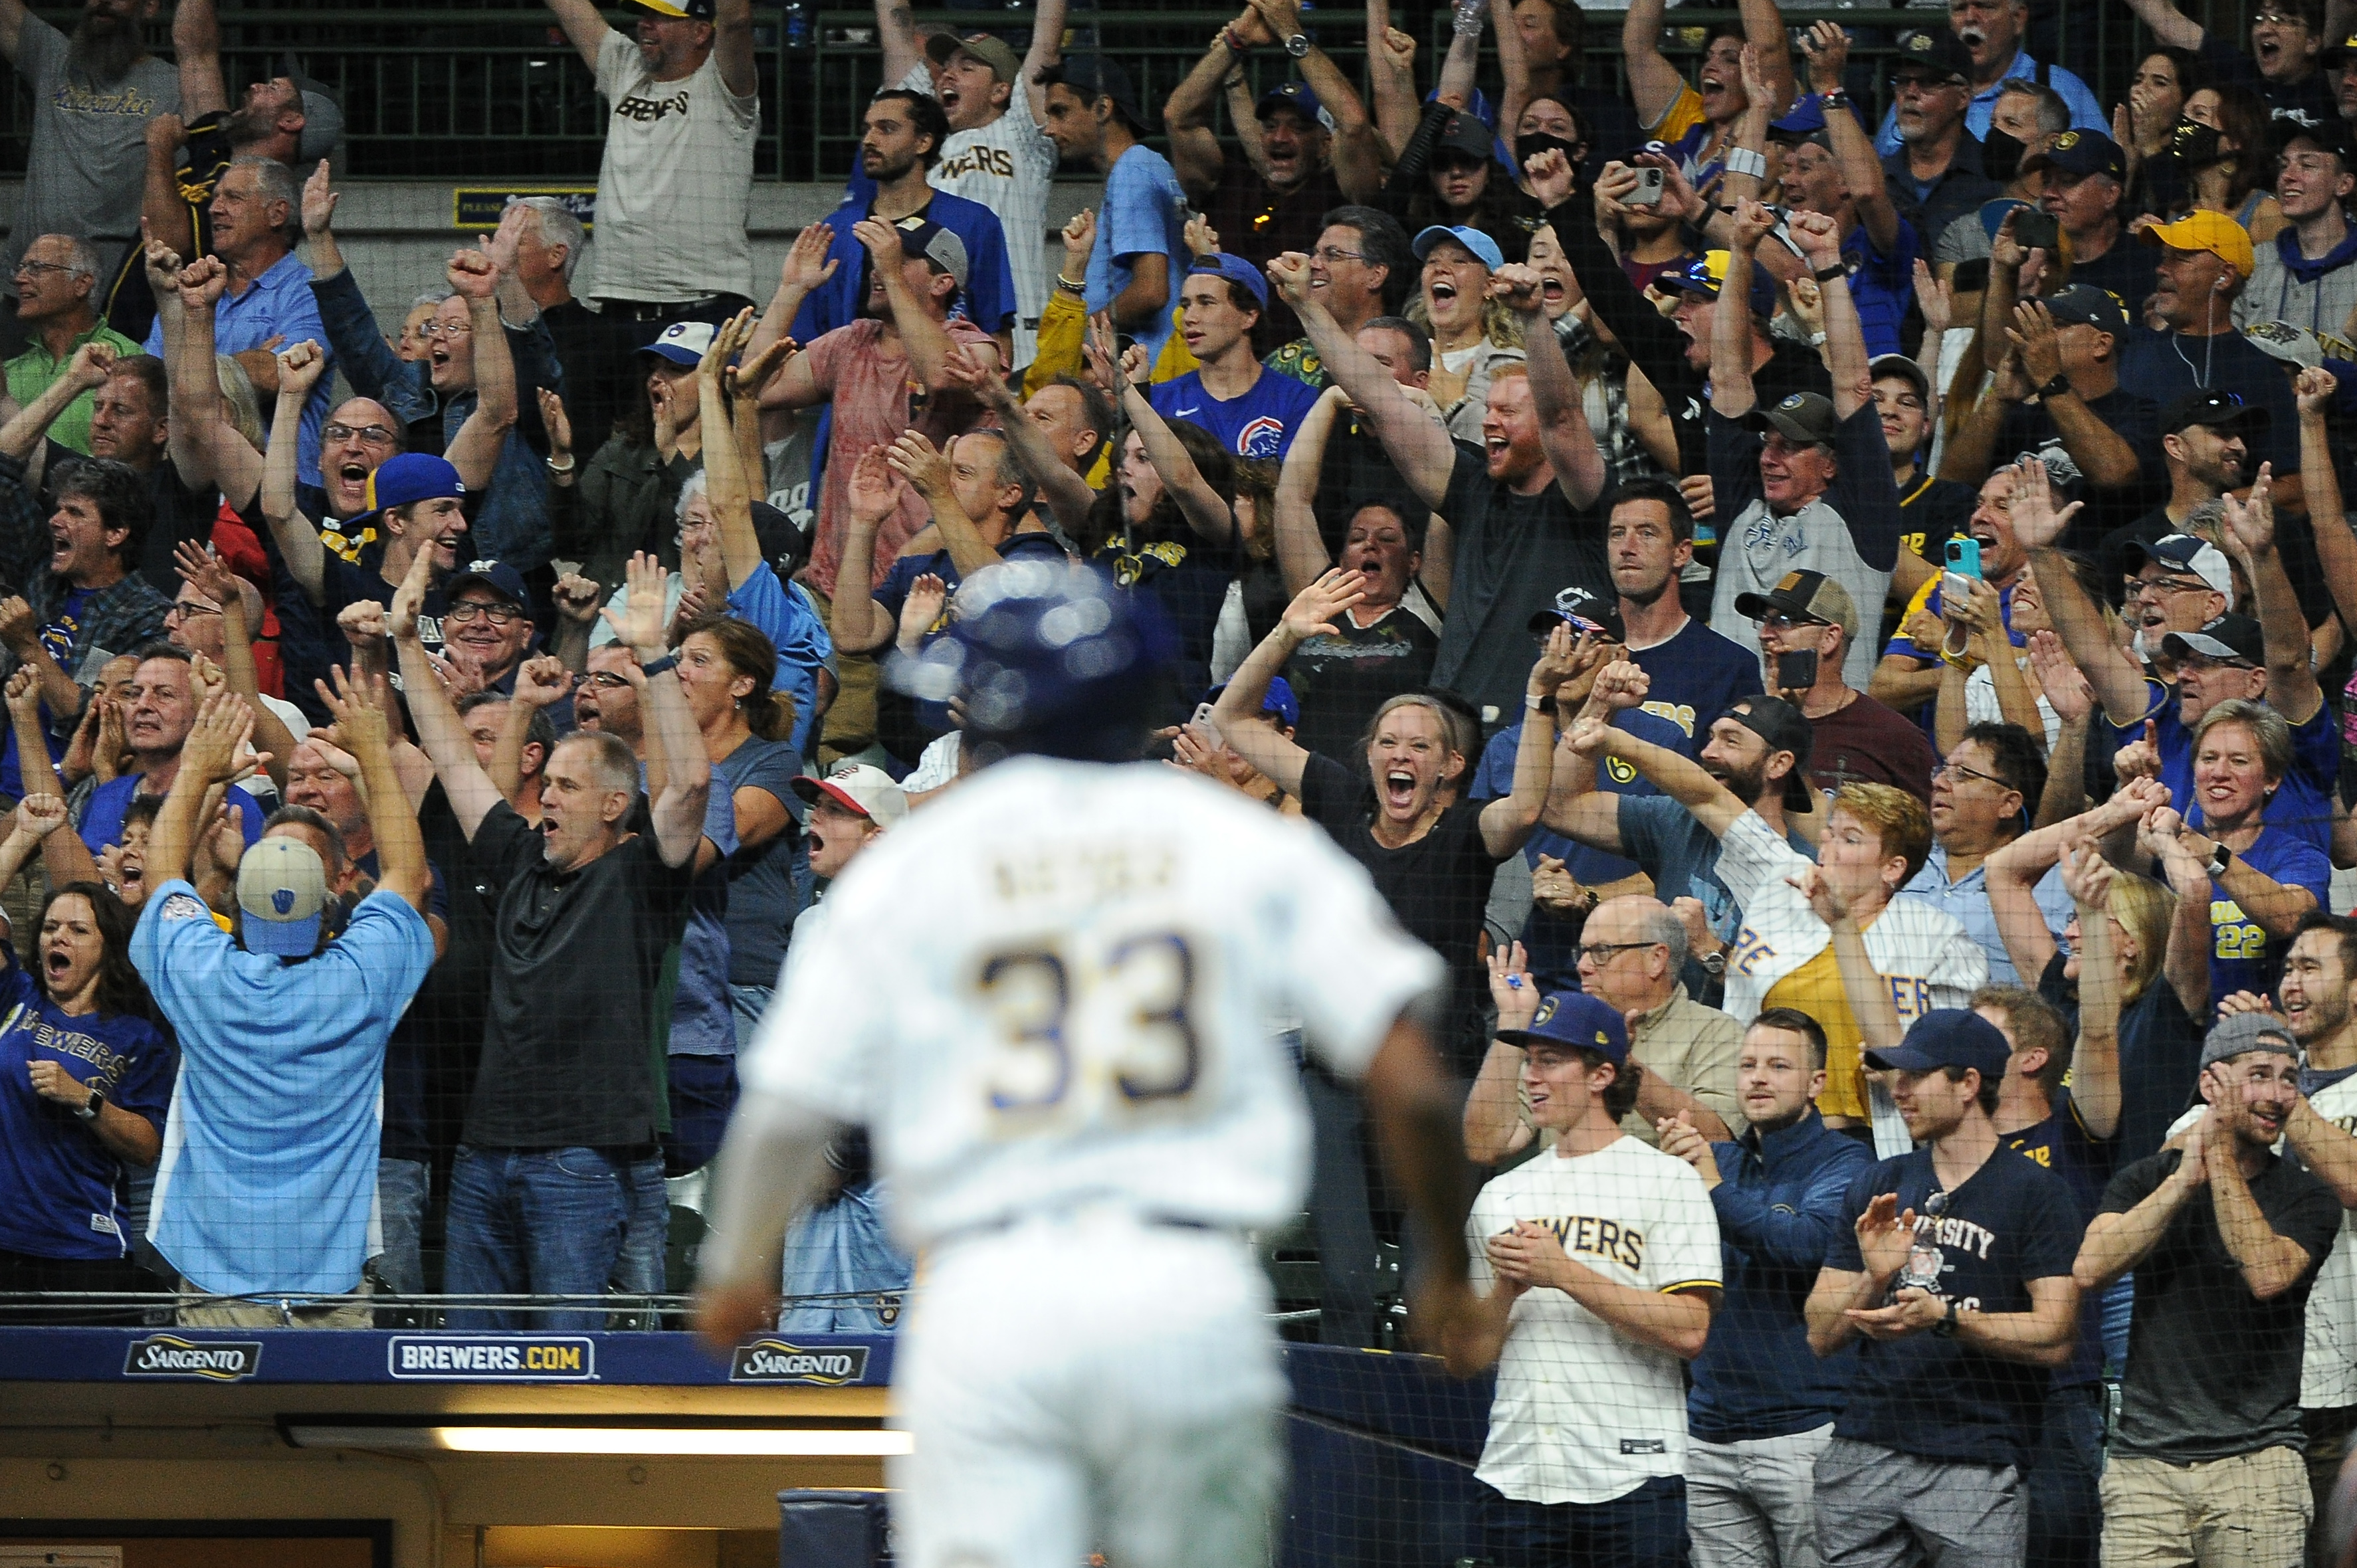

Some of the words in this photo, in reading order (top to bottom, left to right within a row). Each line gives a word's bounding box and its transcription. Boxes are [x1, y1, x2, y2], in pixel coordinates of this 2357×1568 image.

[940, 145, 1014, 179] WERS
[2216, 924, 2267, 959] 22
[977, 930, 1201, 1113] 33
[1500, 1215, 1643, 1272] WERS
[401, 1345, 581, 1370] BREWERS.COM
